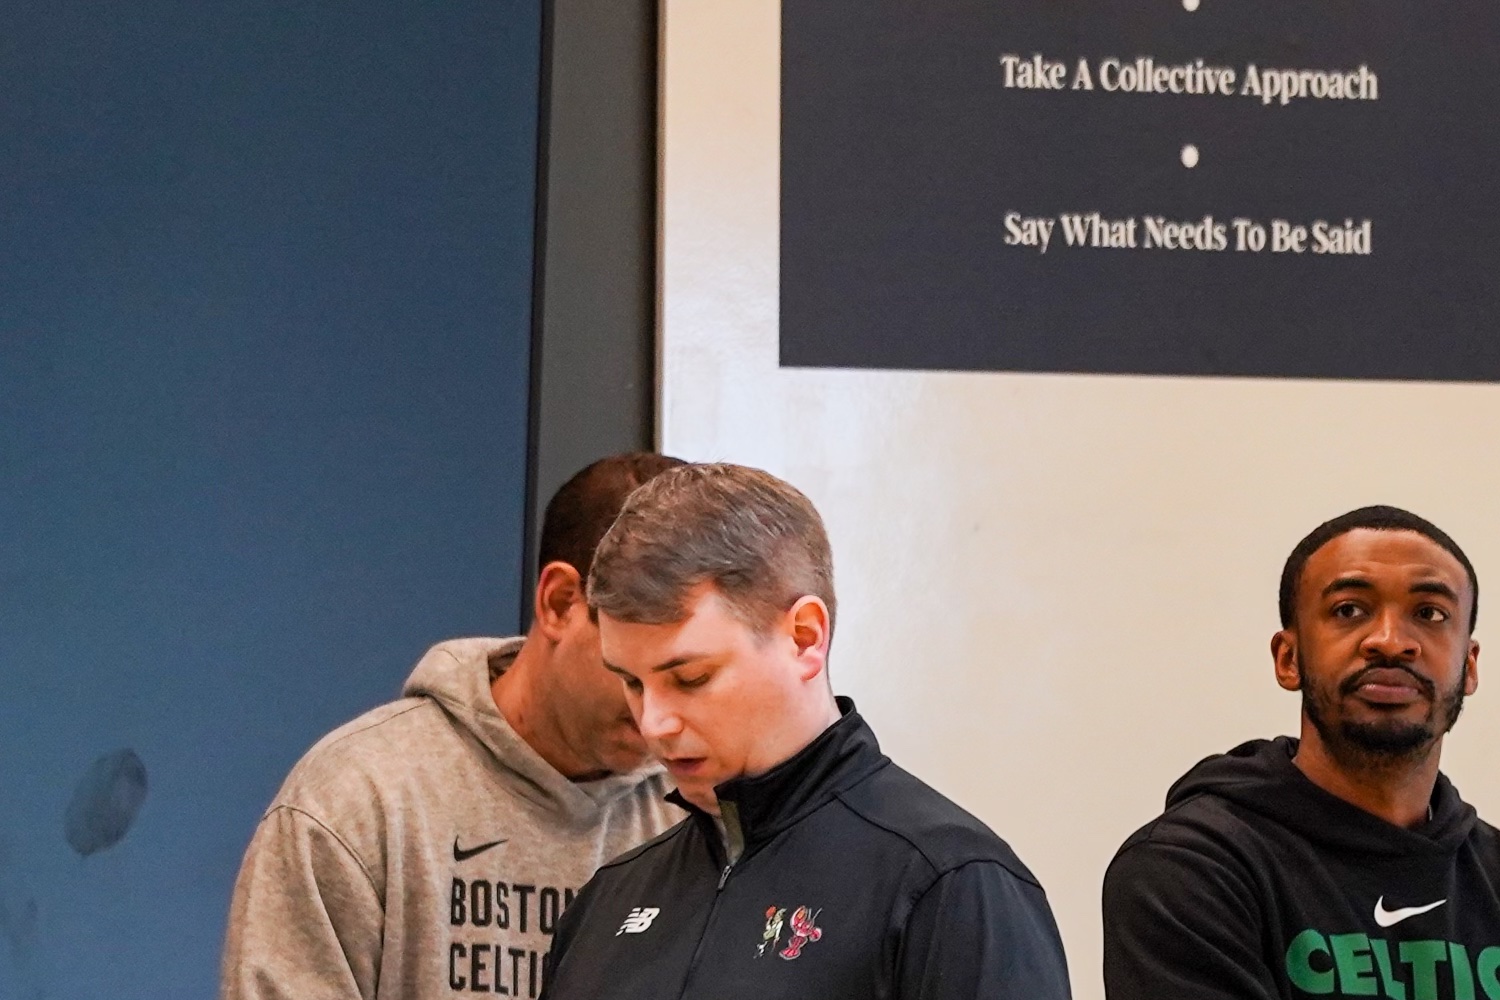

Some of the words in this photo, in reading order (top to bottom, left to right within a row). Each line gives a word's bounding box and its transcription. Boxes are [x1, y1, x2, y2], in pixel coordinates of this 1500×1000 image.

[1000, 53, 1067, 90] Take
[1071, 58, 1095, 91] A
[1100, 56, 1236, 96] Collective
[1241, 63, 1379, 105] Approach
[1004, 212, 1055, 254] Say
[1060, 213, 1138, 249] What
[1143, 214, 1228, 251] Needs
[1232, 217, 1267, 252] To
[1271, 219, 1308, 253] Be
[1311, 218, 1372, 255] Said
